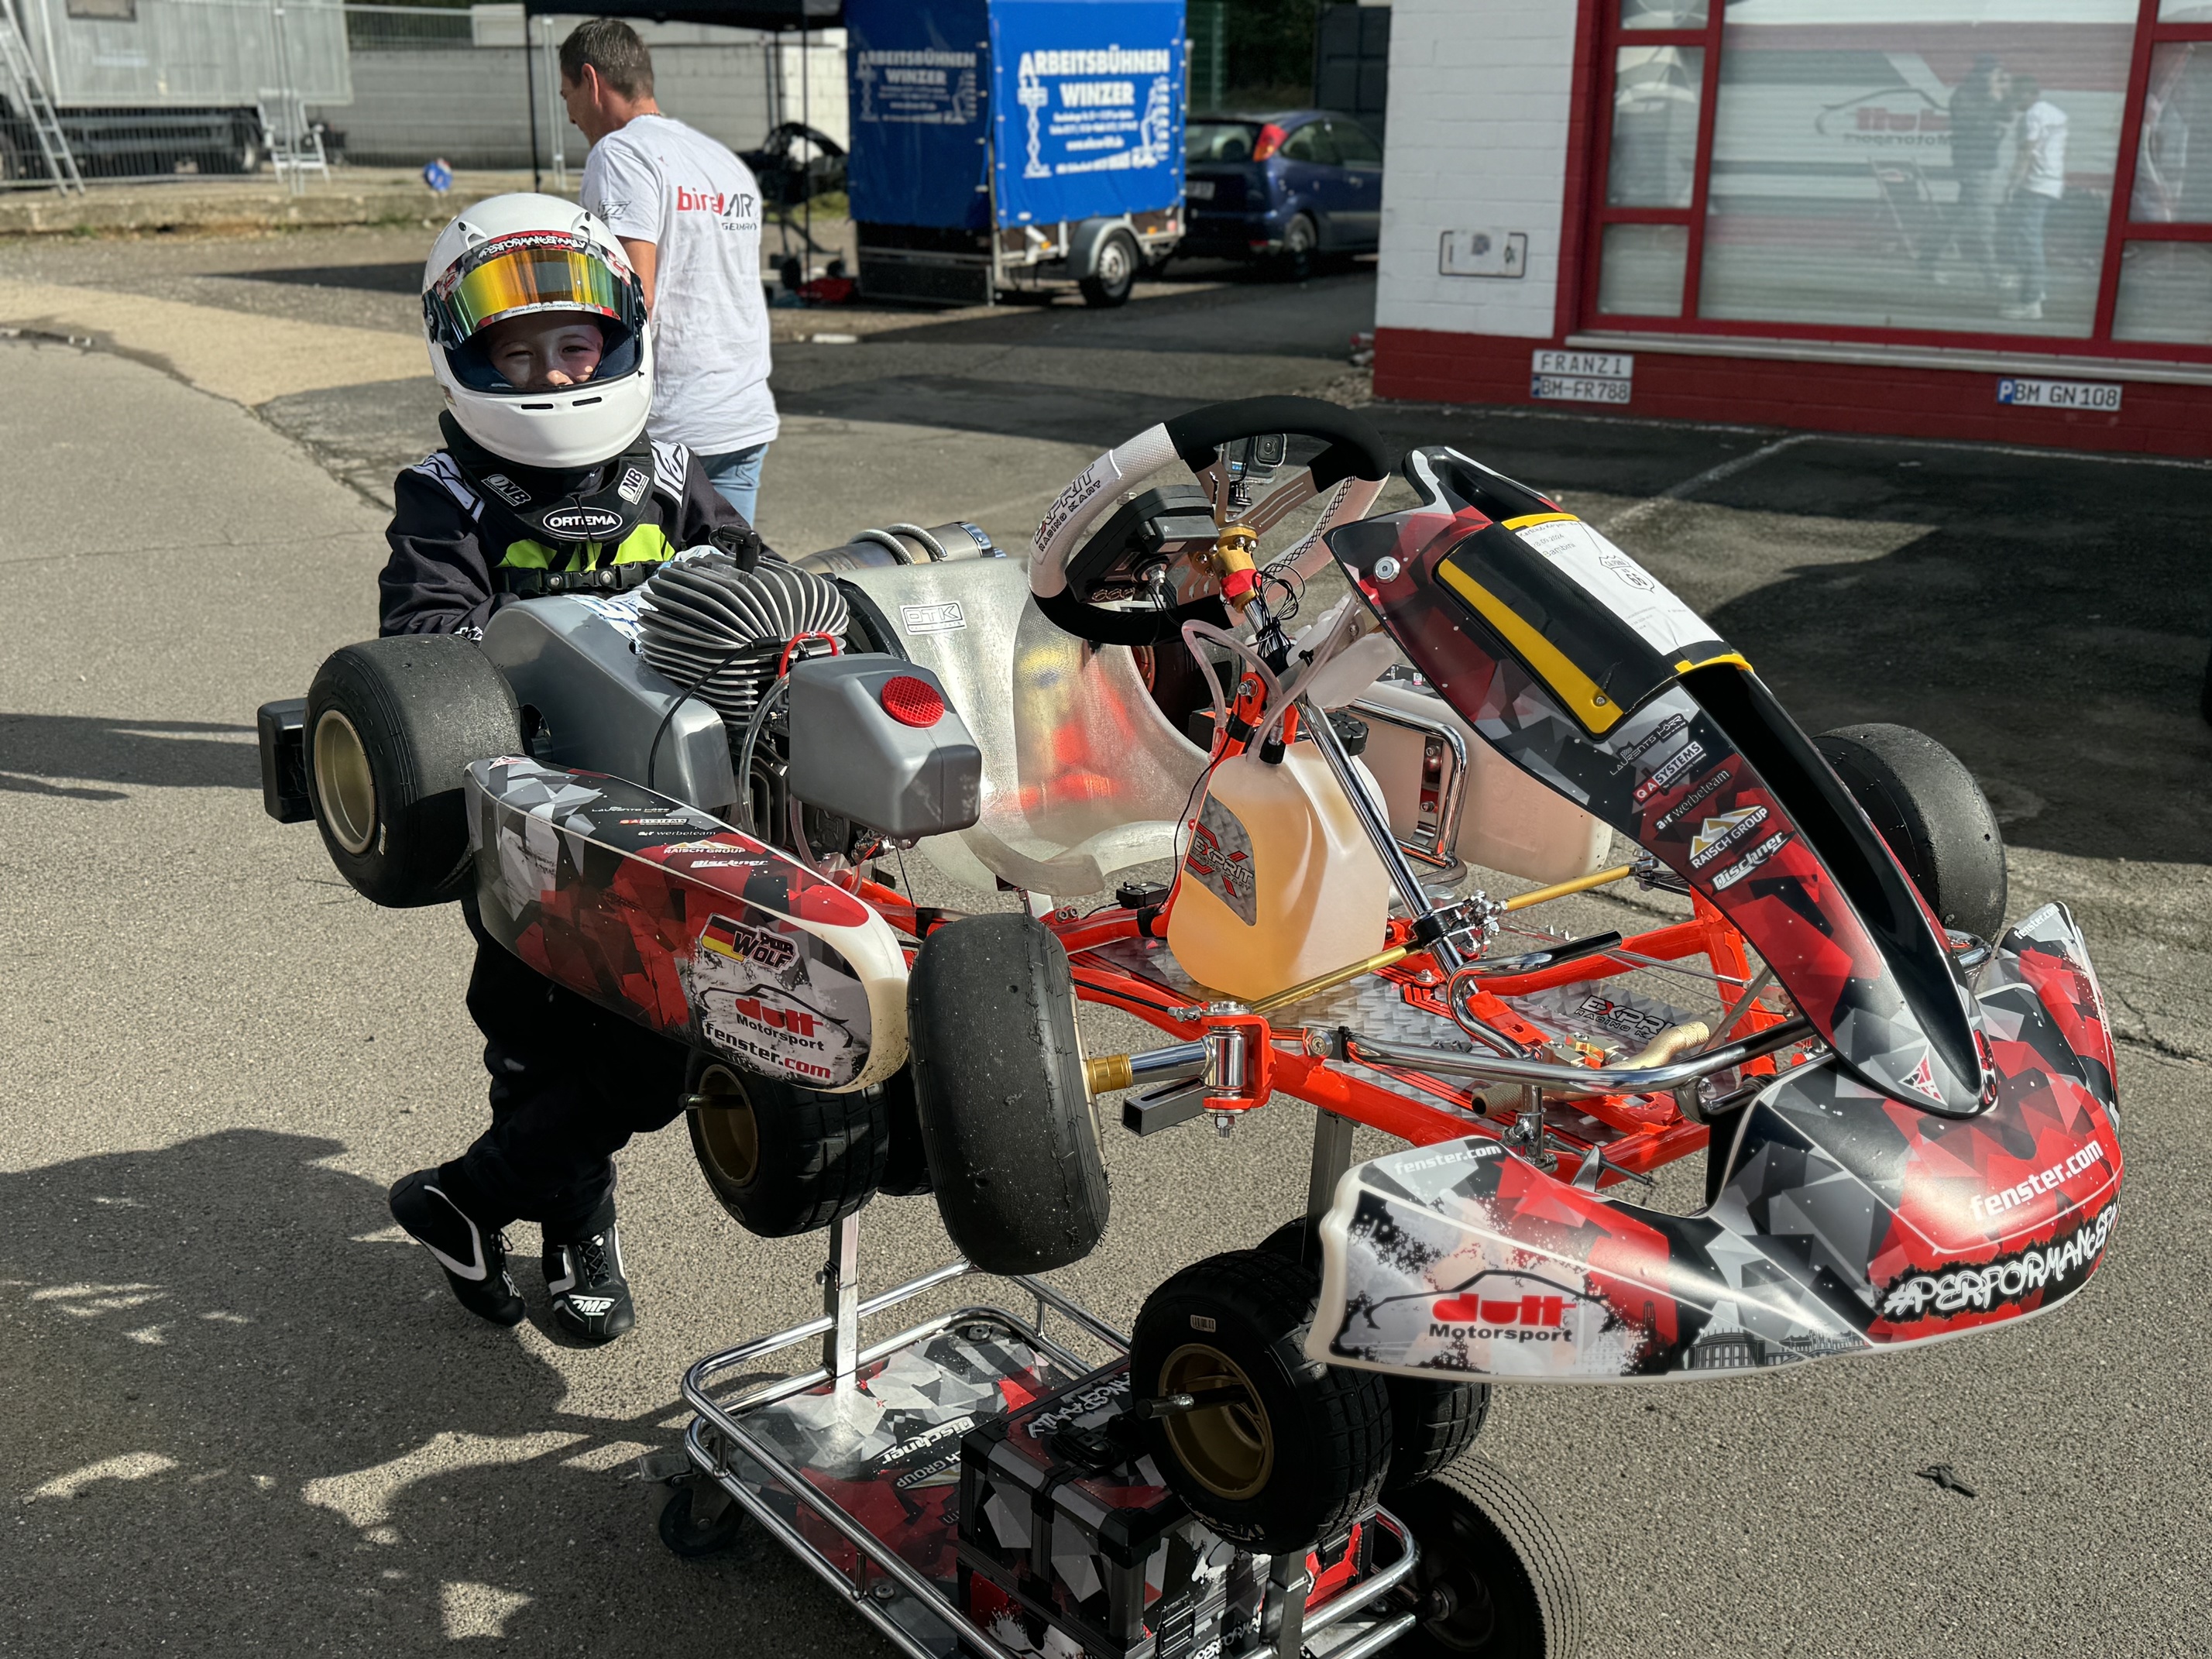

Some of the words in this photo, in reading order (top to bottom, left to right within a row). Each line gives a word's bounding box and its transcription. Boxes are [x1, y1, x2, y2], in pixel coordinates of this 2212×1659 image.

[857, 47, 977, 68] ARBEITSBÜHNEN
[1018, 44, 1170, 78] ARBEITSBÜHNEN
[884, 68, 947, 85] WINZER
[1059, 81, 1135, 107] WINZER
[1540, 353, 1621, 374] FRANZI
[2014, 383, 2040, 403] BM
[549, 514, 617, 528] ORTEMA
[1039, 512, 1067, 551] RACING
[1068, 480, 1101, 512] KART
[1542, 542, 1576, 558] Bambini
[905, 605, 960, 623] OTK
[1609, 734, 1657, 775] LAURENTS
[1655, 743, 1700, 784] SYSTEMS
[1672, 770, 1730, 818] werbeteam
[1691, 836, 1733, 868] RAISCH
[1733, 808, 1768, 840] GROUP
[1193, 836, 1254, 884] EXPRIT
[2014, 905, 2060, 939] fenster.com
[732, 932, 792, 969] WOLF
[1574, 1008, 1631, 1032] RACING
[1579, 994, 1679, 1036] EXPRI
[737, 1014, 825, 1052] Motorsport
[705, 1022, 831, 1079] fenster.com
[1394, 1146, 1502, 1176] fenster.com
[1970, 1140, 2104, 1221] fenster.com
[1884, 1202, 2119, 1315] #PERFORMANCEFA
[1429, 1323, 1573, 1344] Motorsport
[882, 1416, 974, 1465] Dischner
[896, 1459, 946, 1488] GROUP
